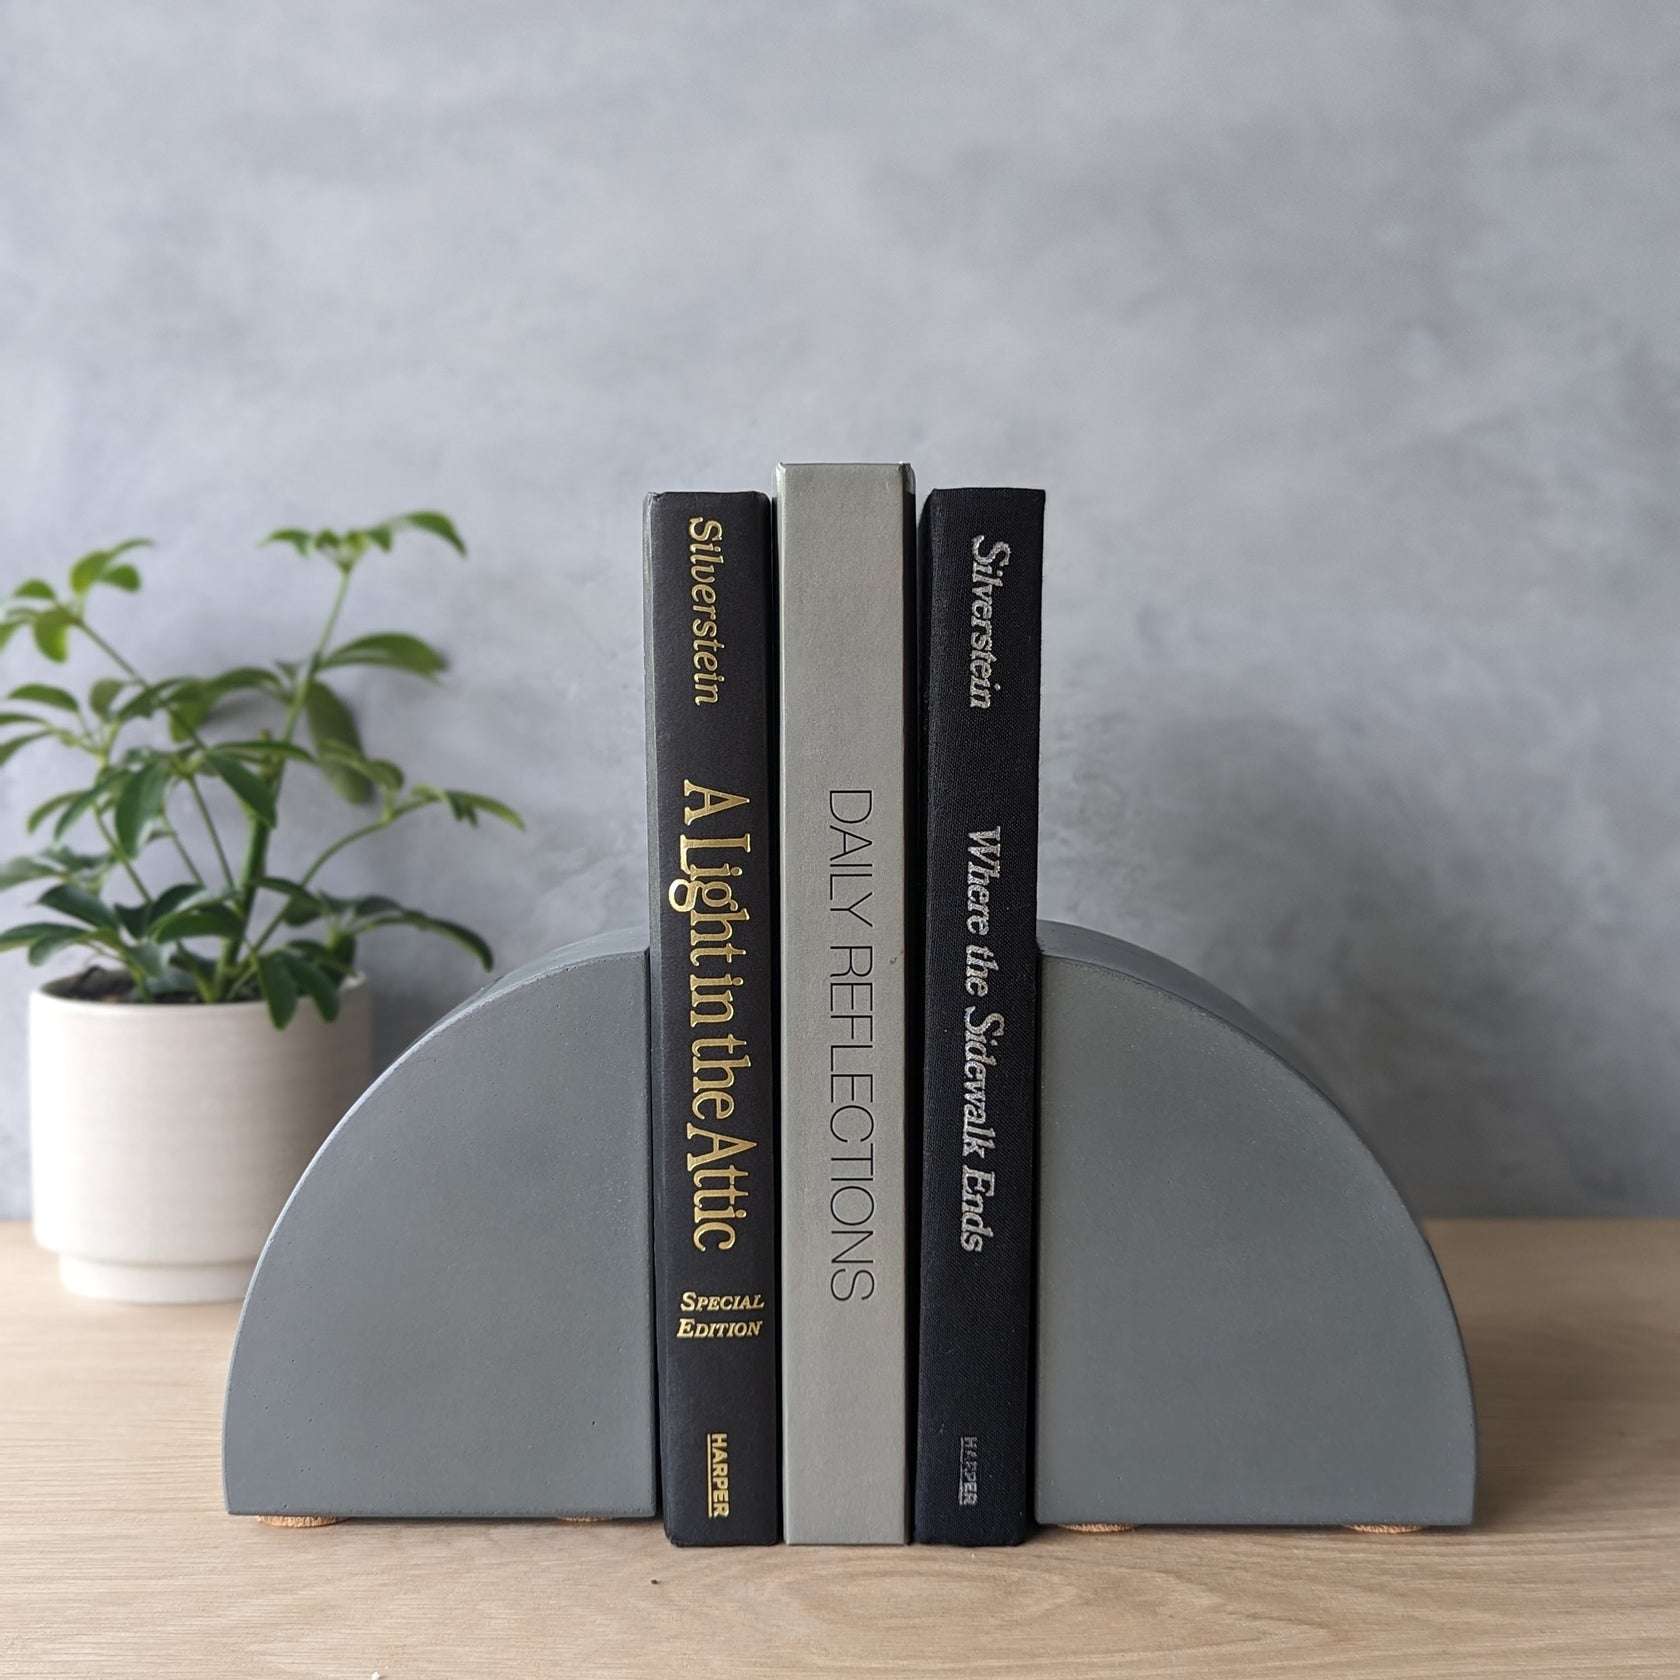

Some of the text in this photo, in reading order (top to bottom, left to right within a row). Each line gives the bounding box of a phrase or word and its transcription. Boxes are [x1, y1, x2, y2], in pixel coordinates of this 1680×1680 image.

[688, 516, 725, 705] Silverstein
[969, 535, 1011, 709] Silverstein
[668, 779, 757, 1252] A Light in the Attic
[829, 790, 875, 1301] DAILY REFLECTIONS
[960, 825, 1005, 1252] Where the Sidewalk Ends
[676, 1318, 763, 1339] EDITION
[680, 1292, 765, 1312] SPECIAL
[708, 1432, 730, 1519] HARPER
